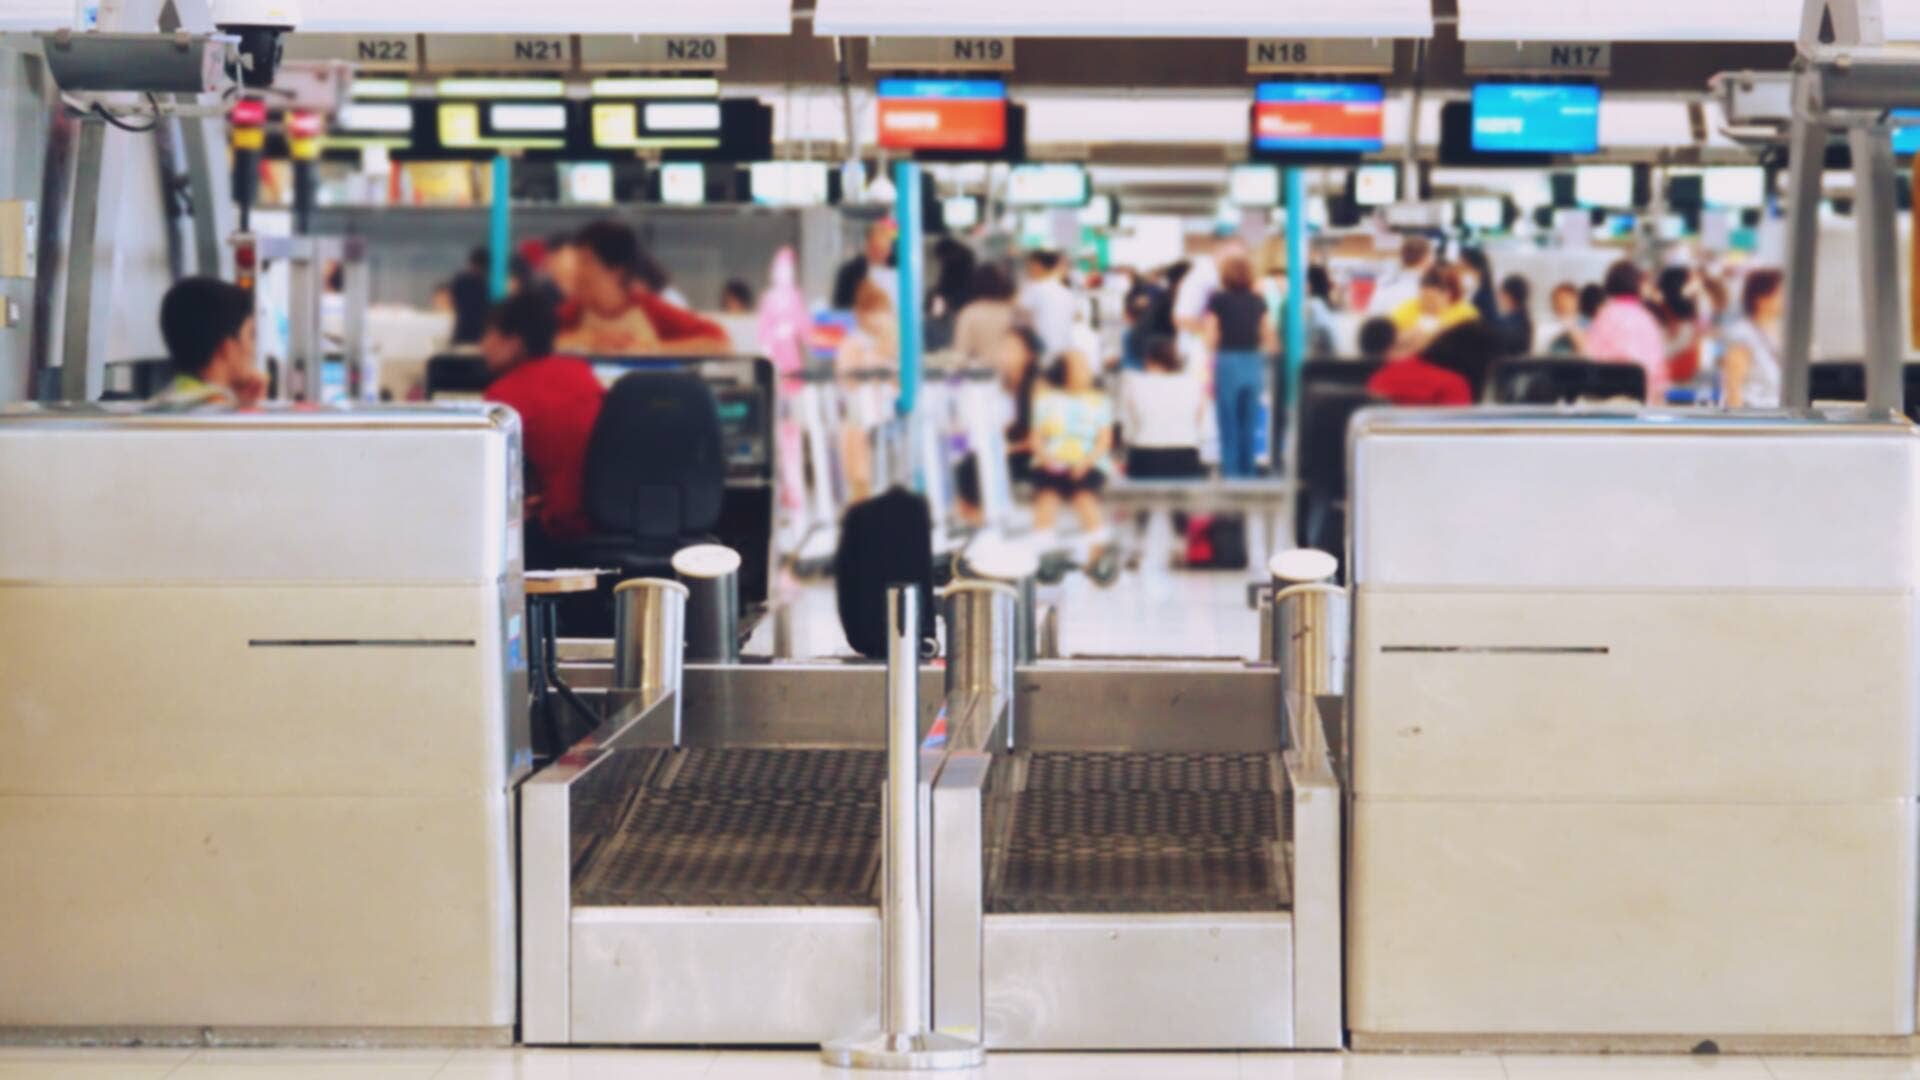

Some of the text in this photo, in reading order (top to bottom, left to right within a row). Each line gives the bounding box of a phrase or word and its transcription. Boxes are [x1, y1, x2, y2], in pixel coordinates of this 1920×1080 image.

[357, 40, 407, 61] N22
[514, 40, 563, 62] N21
[666, 39, 717, 60] N20
[953, 39, 1004, 61] N19
[1257, 42, 1307, 63] N18
[1550, 46, 1601, 68] N17
